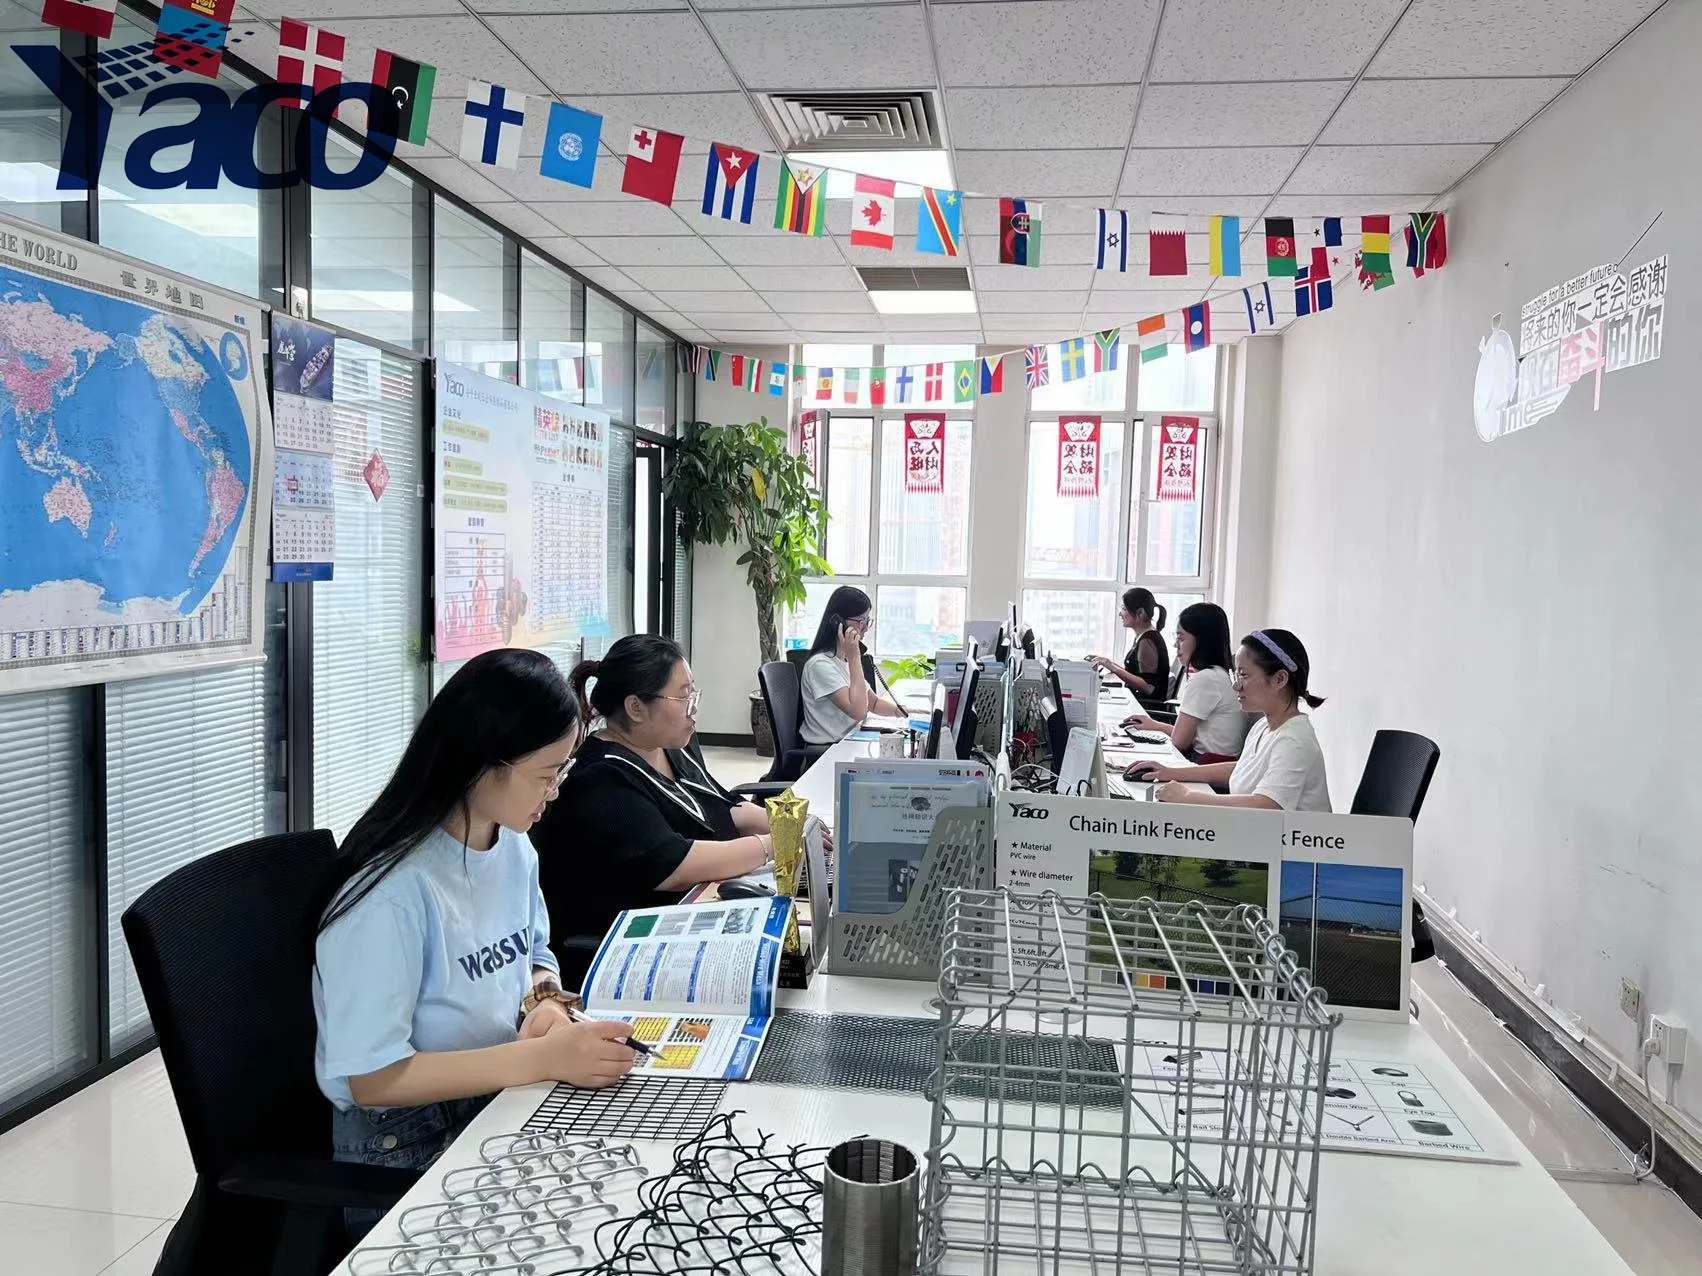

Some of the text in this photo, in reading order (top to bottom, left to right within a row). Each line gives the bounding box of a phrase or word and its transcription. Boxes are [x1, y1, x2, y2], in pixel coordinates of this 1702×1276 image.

[22, 238, 77, 271] WORLD
[1590, 262, 1612, 283] future
[1008, 802, 1049, 820] Yaco
[1069, 815, 1216, 842] Chain Link Fence
[1020, 841, 1052, 852] Material
[1292, 830, 1345, 849] Fence
[1019, 869, 1074, 881] Wire diameter
[1450, 1143, 1470, 1151] Wire
